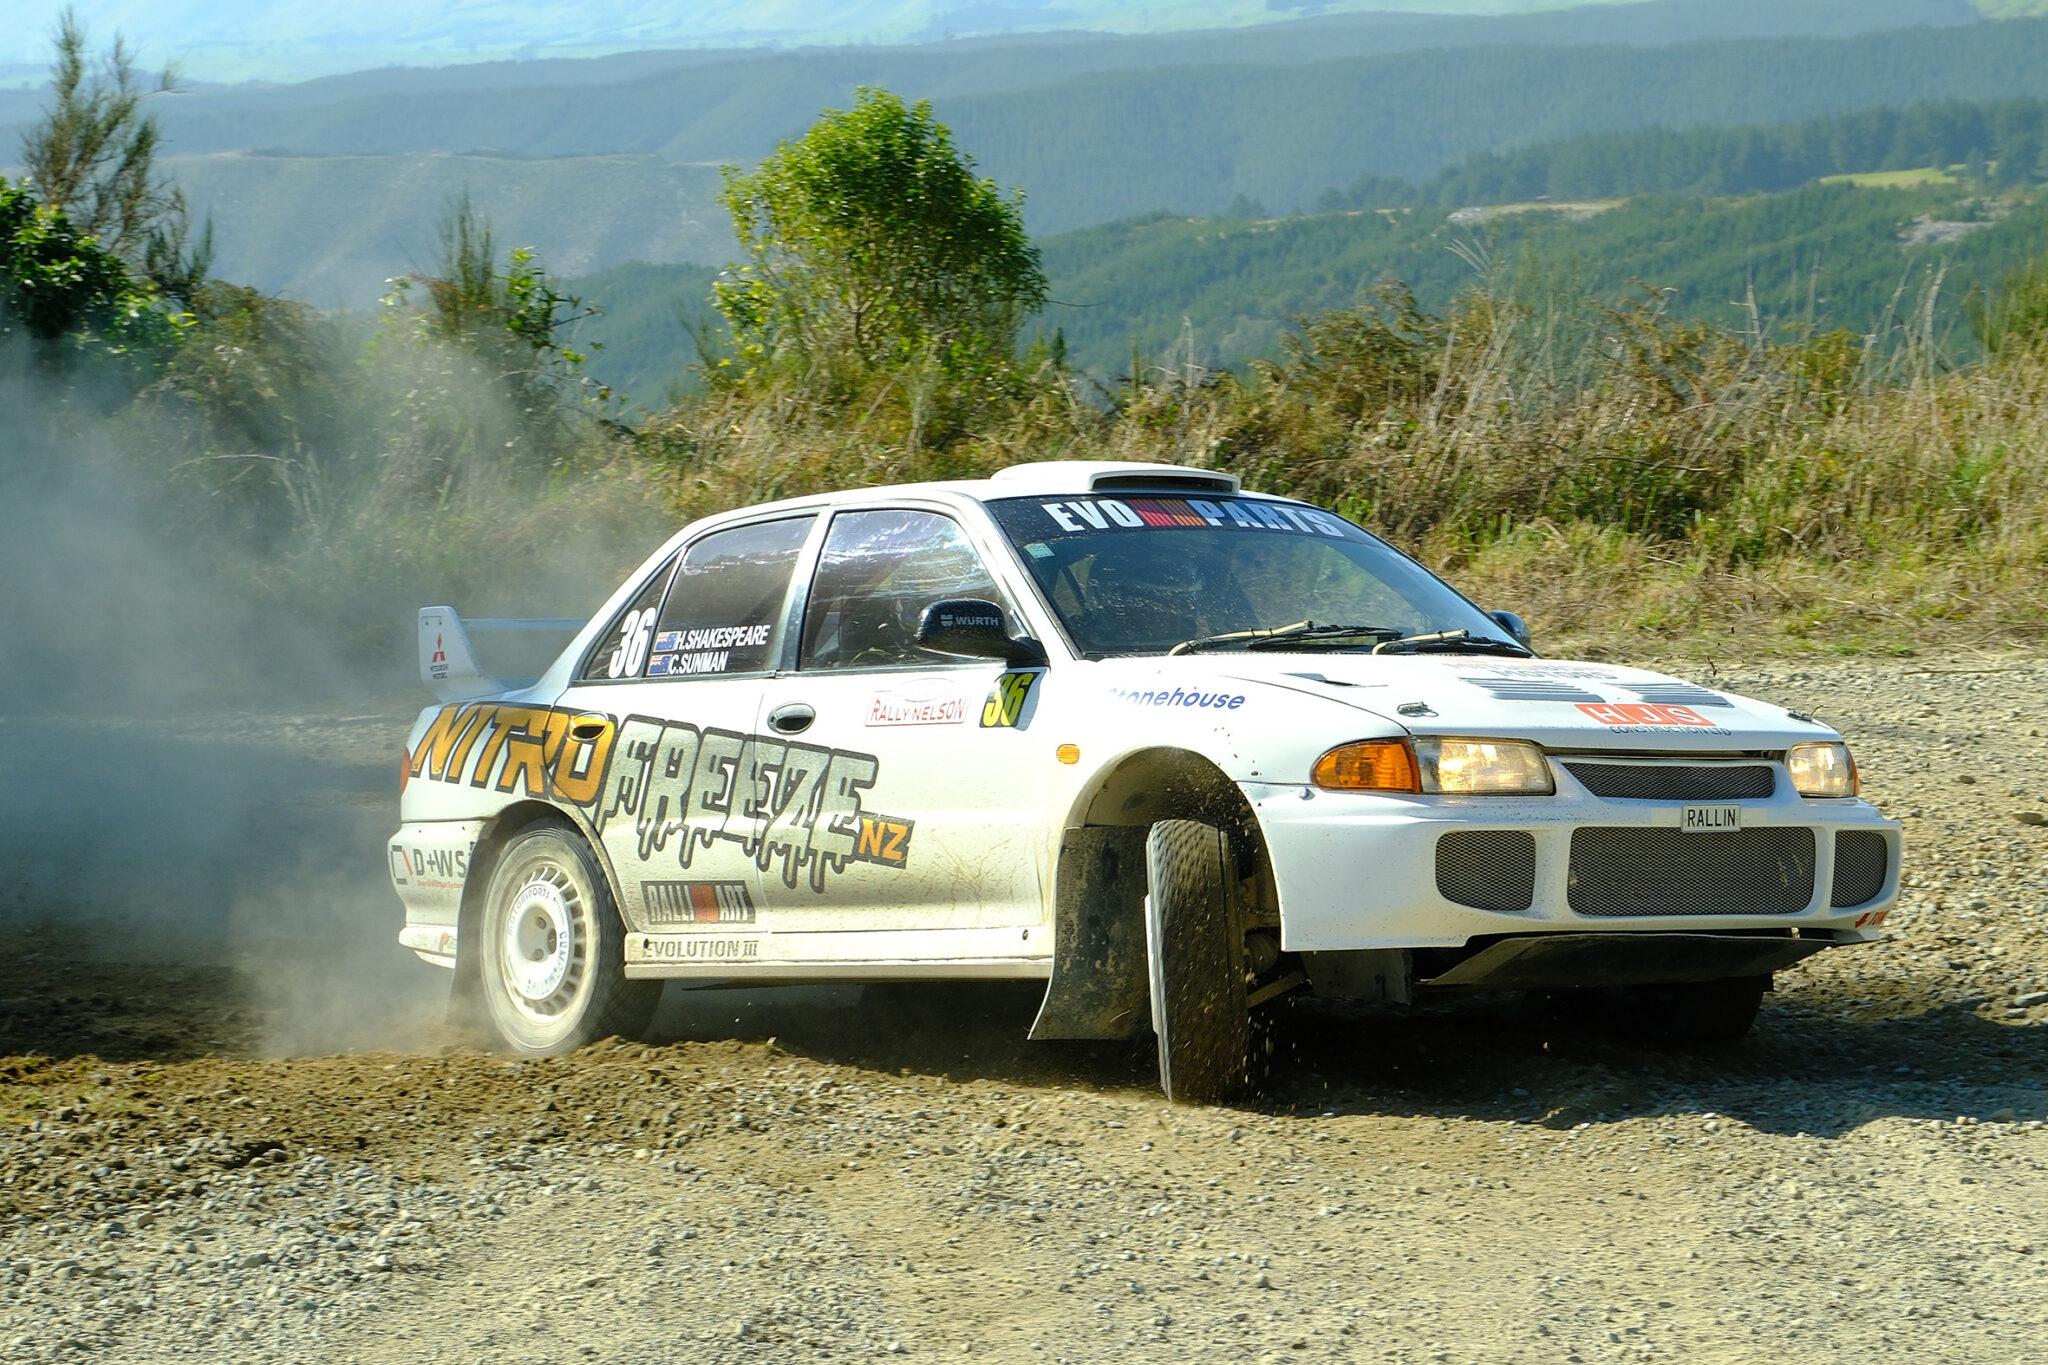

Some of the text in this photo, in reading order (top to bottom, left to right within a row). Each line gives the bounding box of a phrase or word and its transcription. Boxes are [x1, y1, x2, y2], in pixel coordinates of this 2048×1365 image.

[1041, 500, 1345, 537] EVO PARTS
[608, 607, 657, 679] 36
[674, 624, 771, 651] H.SHAKESPEARE
[668, 651, 730, 675] C.SUNMAN
[870, 697, 964, 721] RALLY NELSON
[983, 673, 1034, 727] 36
[1583, 706, 1704, 724] HJS
[1610, 725, 1708, 734] CONSTRUCTION
[409, 702, 912, 894] NITRO FREEZE NZ
[1687, 808, 1736, 827] RALLIN
[642, 940, 739, 957] EVOLUTION
